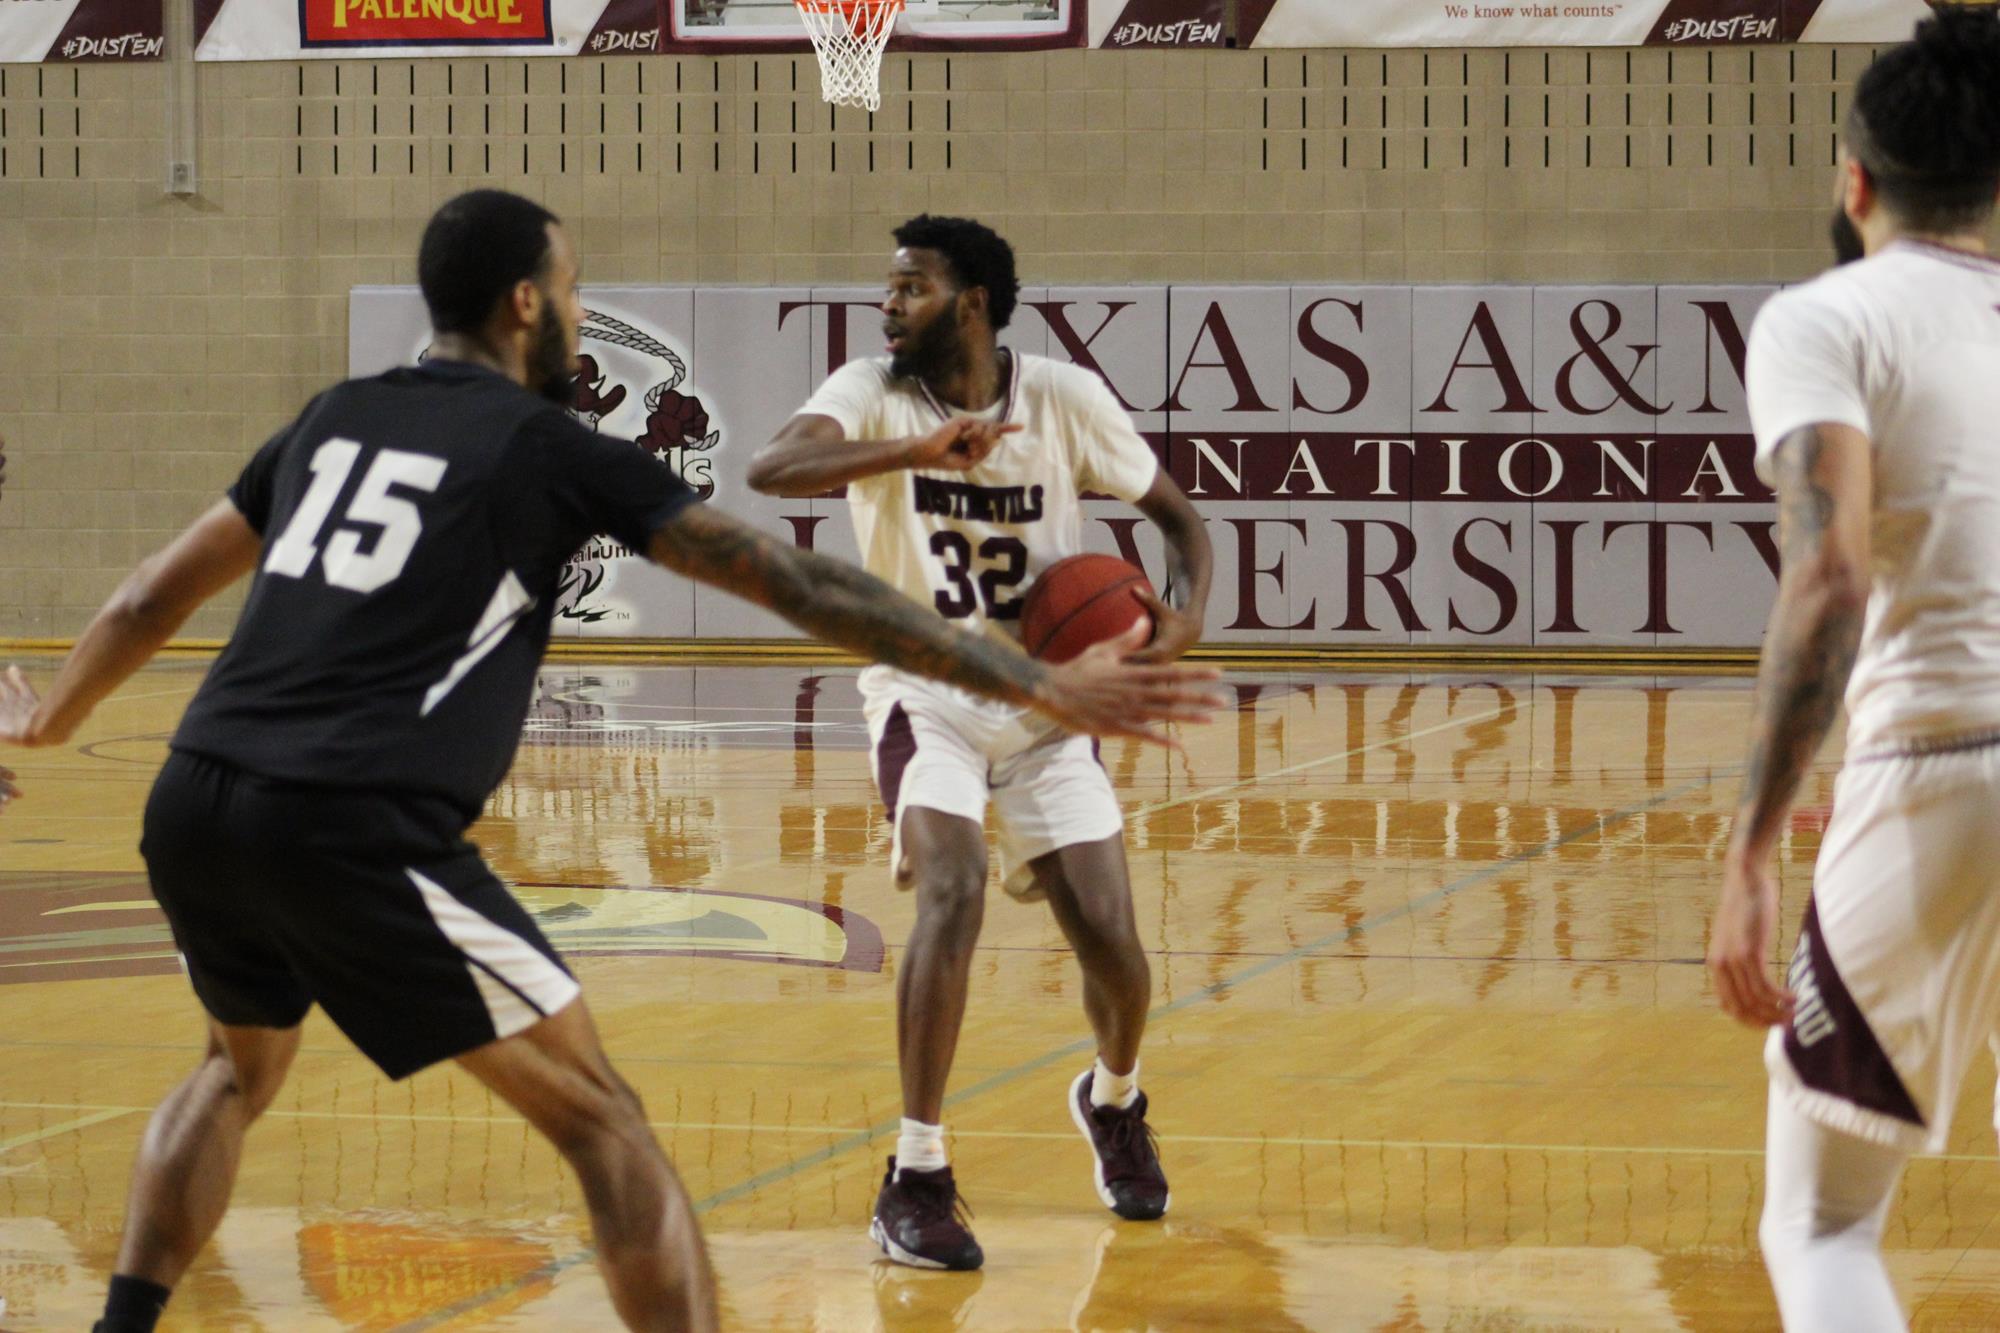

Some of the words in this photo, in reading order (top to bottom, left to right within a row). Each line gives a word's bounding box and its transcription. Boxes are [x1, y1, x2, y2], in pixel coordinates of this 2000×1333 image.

[333, 0, 523, 28] PALENQUE
[591, 28, 660, 53] #DUST
[1444, 5, 1469, 18] We
[1474, 4, 1515, 18] know
[1520, 4, 1559, 18] what
[778, 298, 1370, 415] TXAS
[263, 436, 449, 595] 15
[929, 530, 1028, 620] 32
